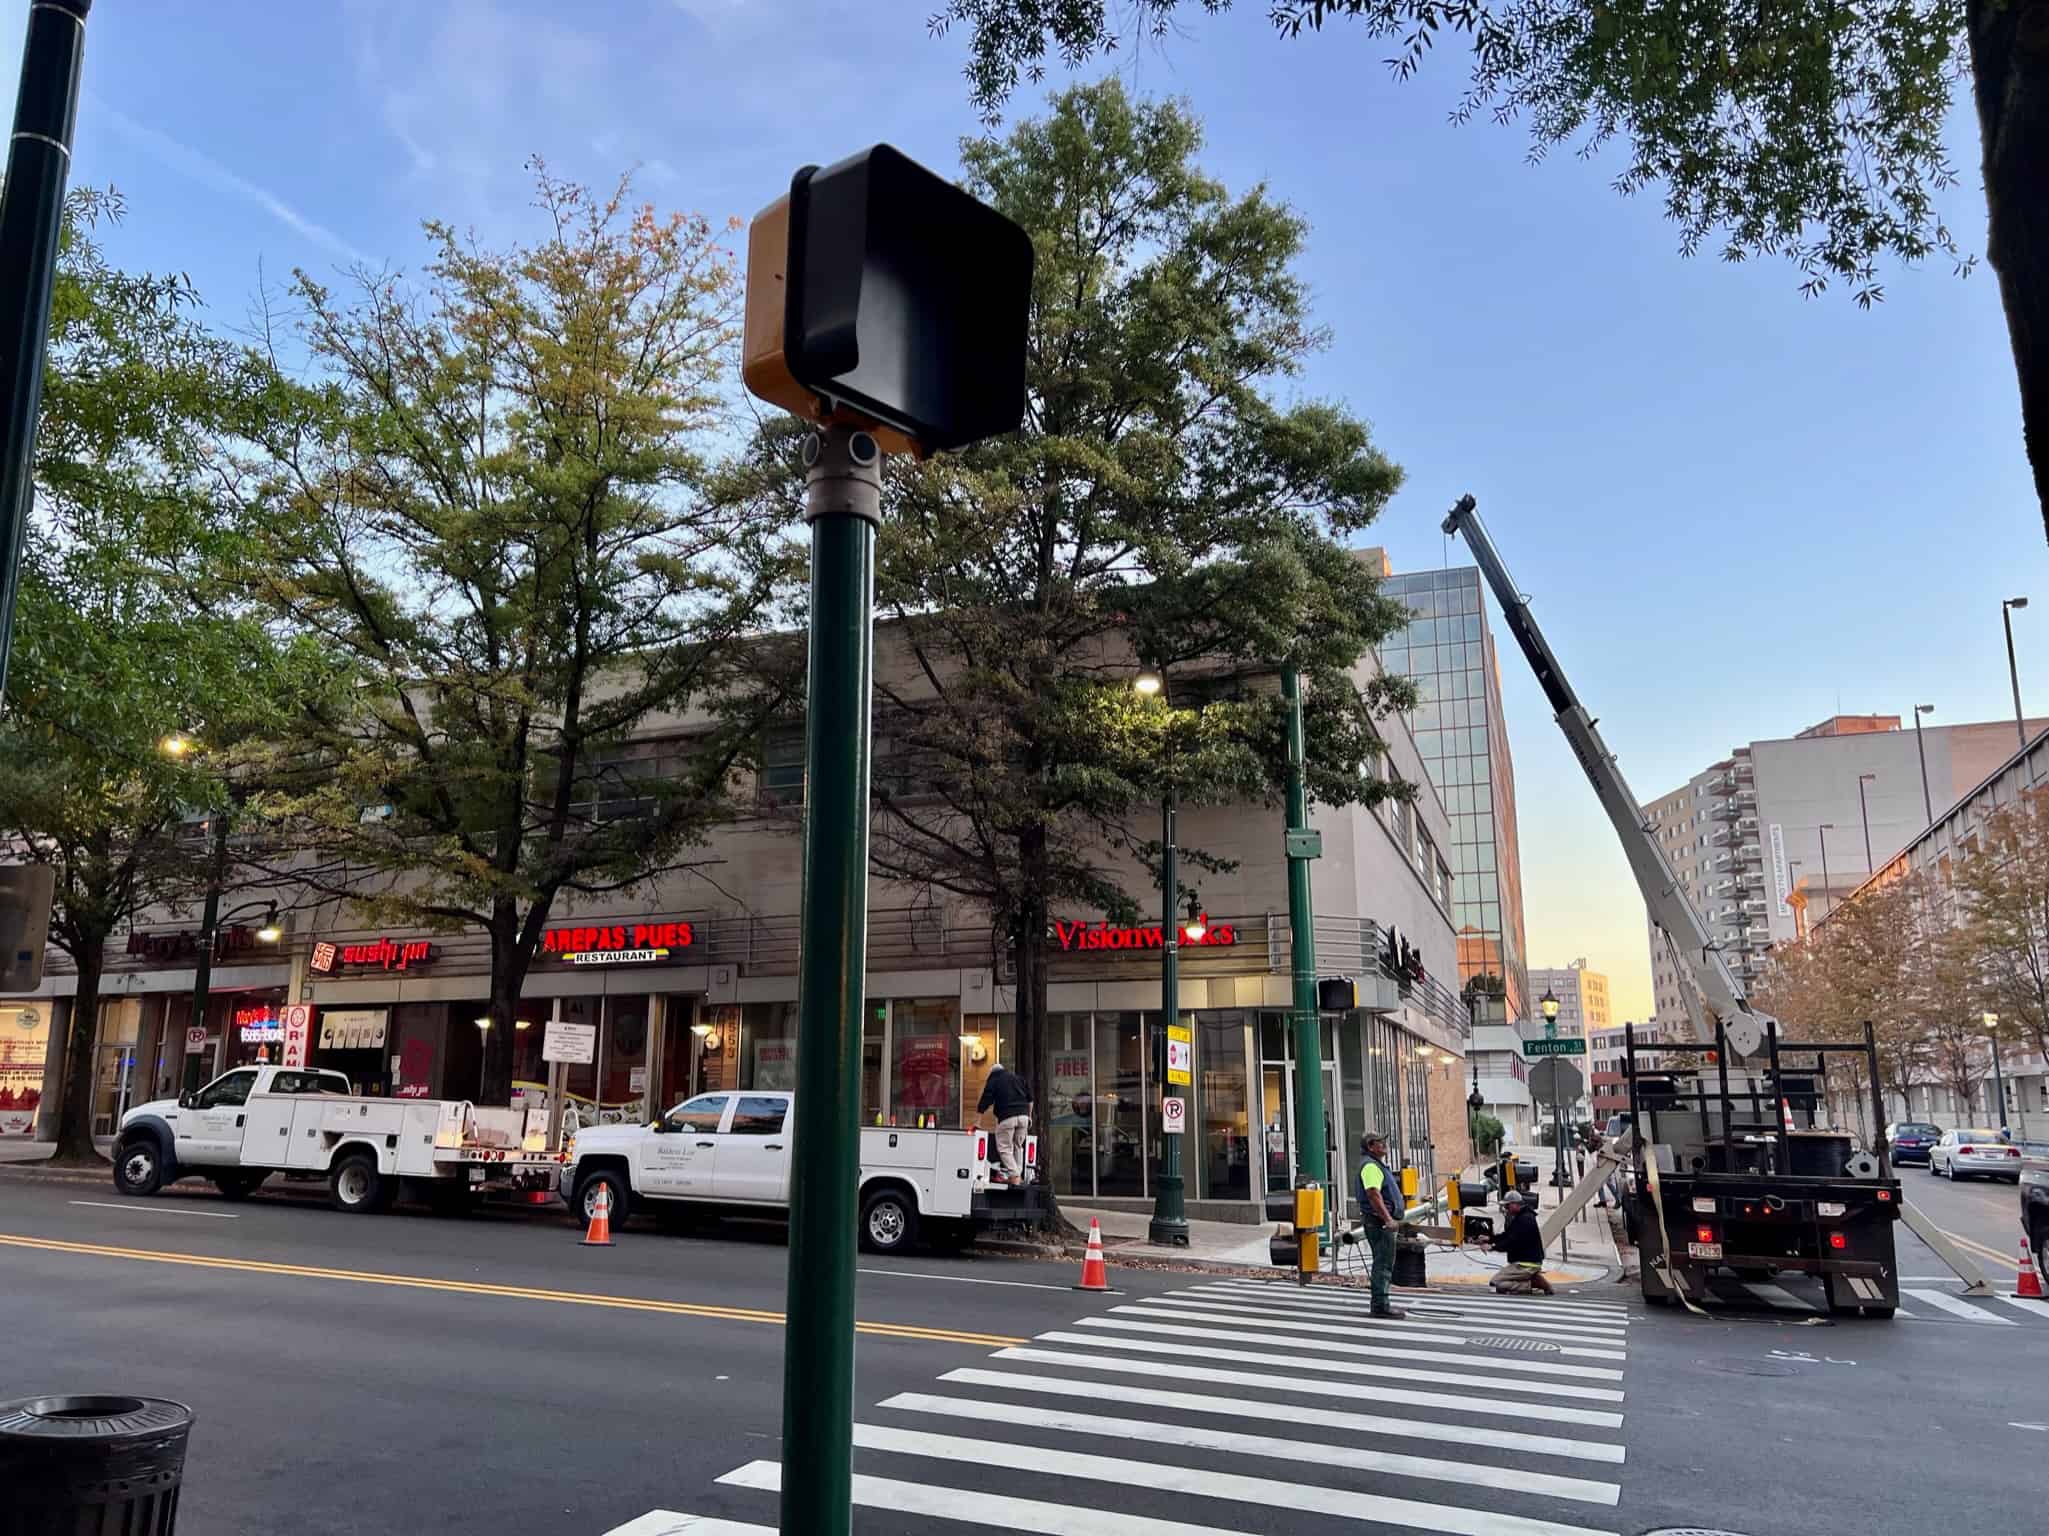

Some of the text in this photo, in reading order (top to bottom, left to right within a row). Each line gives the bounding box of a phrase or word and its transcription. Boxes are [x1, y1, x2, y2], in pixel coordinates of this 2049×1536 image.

[543, 922, 693, 953] AREPAS PUES
[1056, 912, 1233, 950] Visionwks
[343, 936, 399, 970] sushi
[396, 942, 430, 970] jin
[575, 951, 655, 963] RESTAURANT
[1527, 1042, 1567, 1054] Fenton
[1055, 1062, 1088, 1077] FREE
